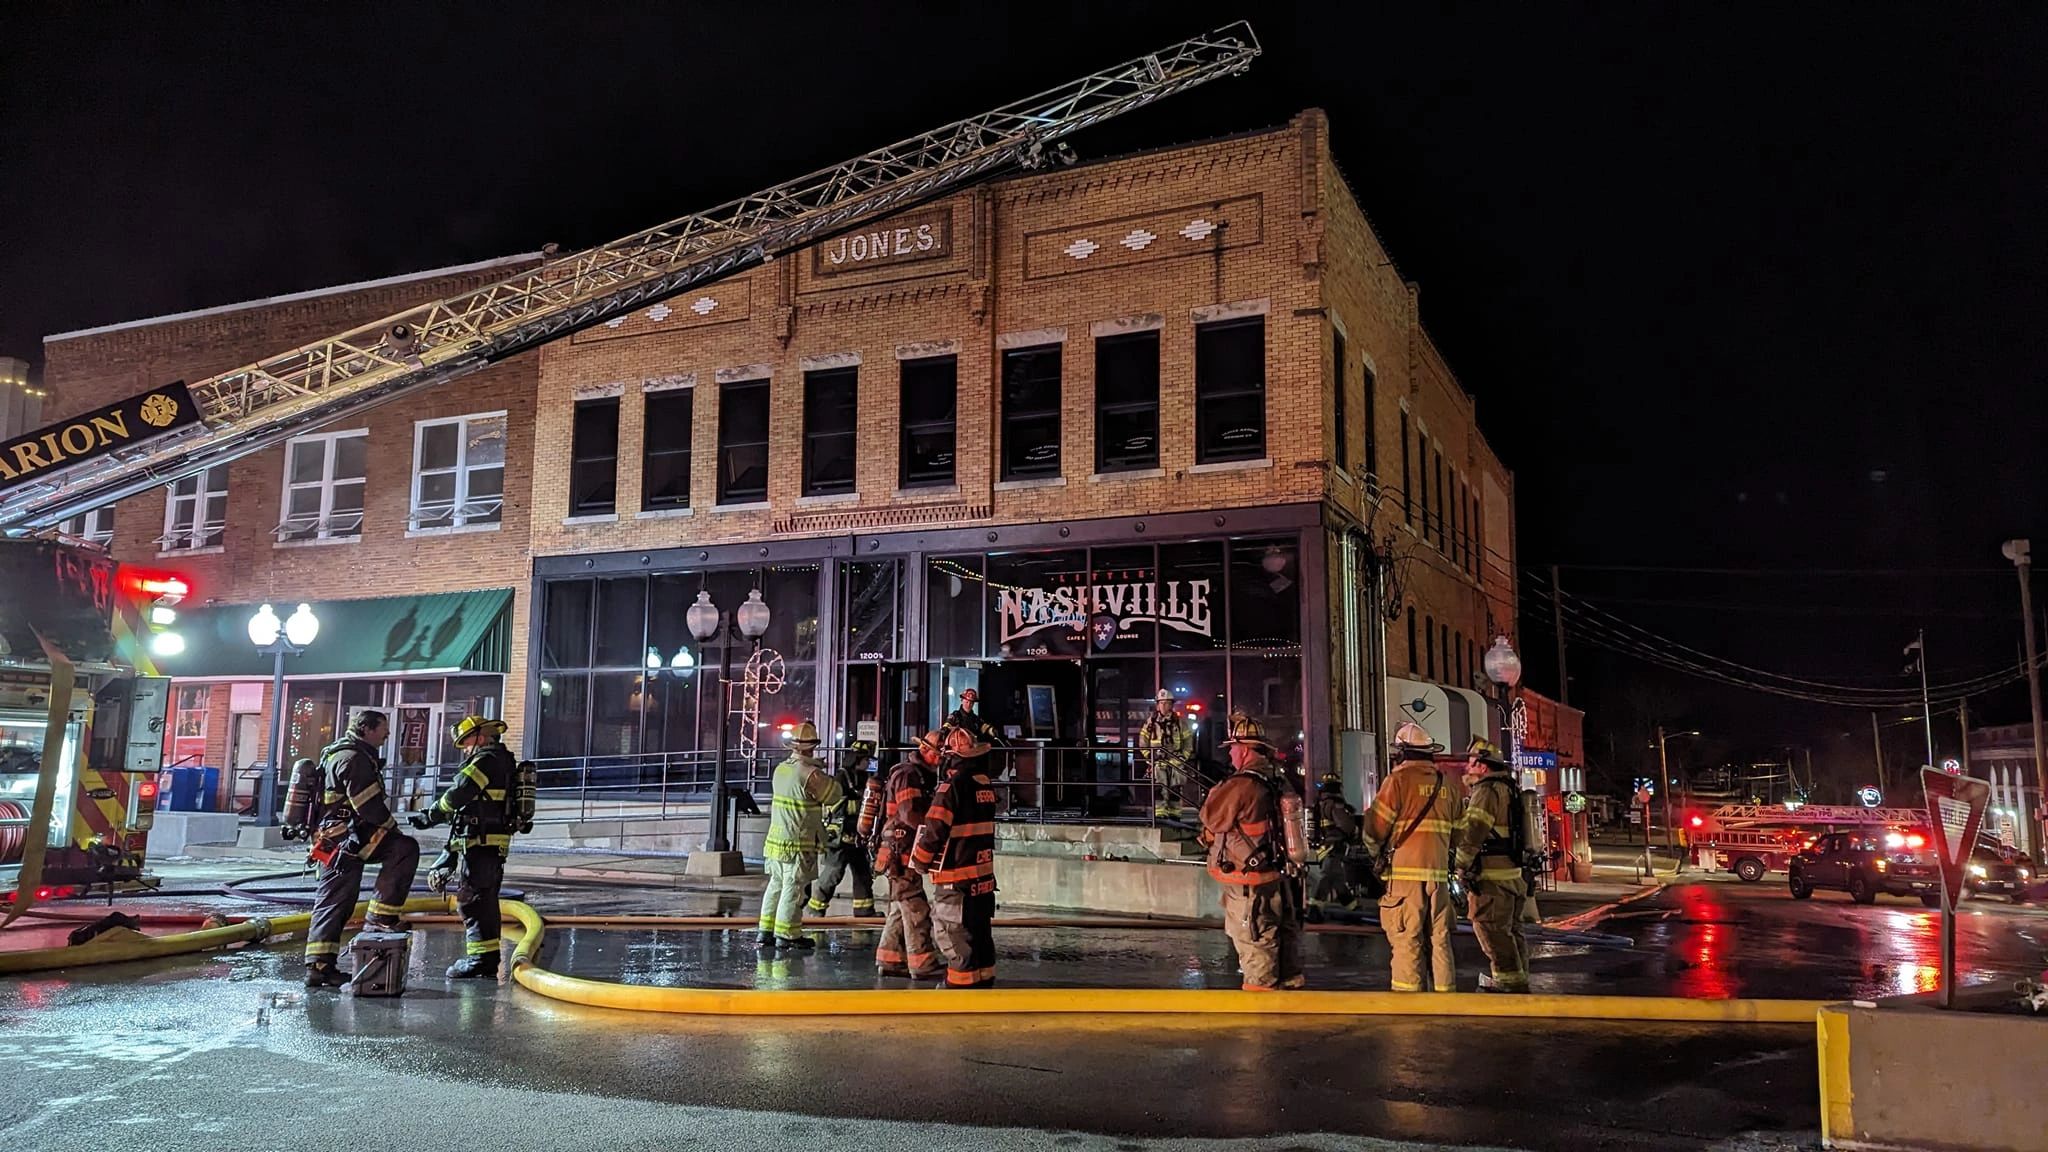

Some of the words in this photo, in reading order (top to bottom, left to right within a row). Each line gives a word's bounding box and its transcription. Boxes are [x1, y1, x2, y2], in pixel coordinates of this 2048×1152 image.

[1060, 570, 1145, 582] LITTLE
[999, 579, 1212, 644] NASHVILLE
[1026, 648, 1048, 656] 1200
[1418, 783, 1448, 799] WCFD
